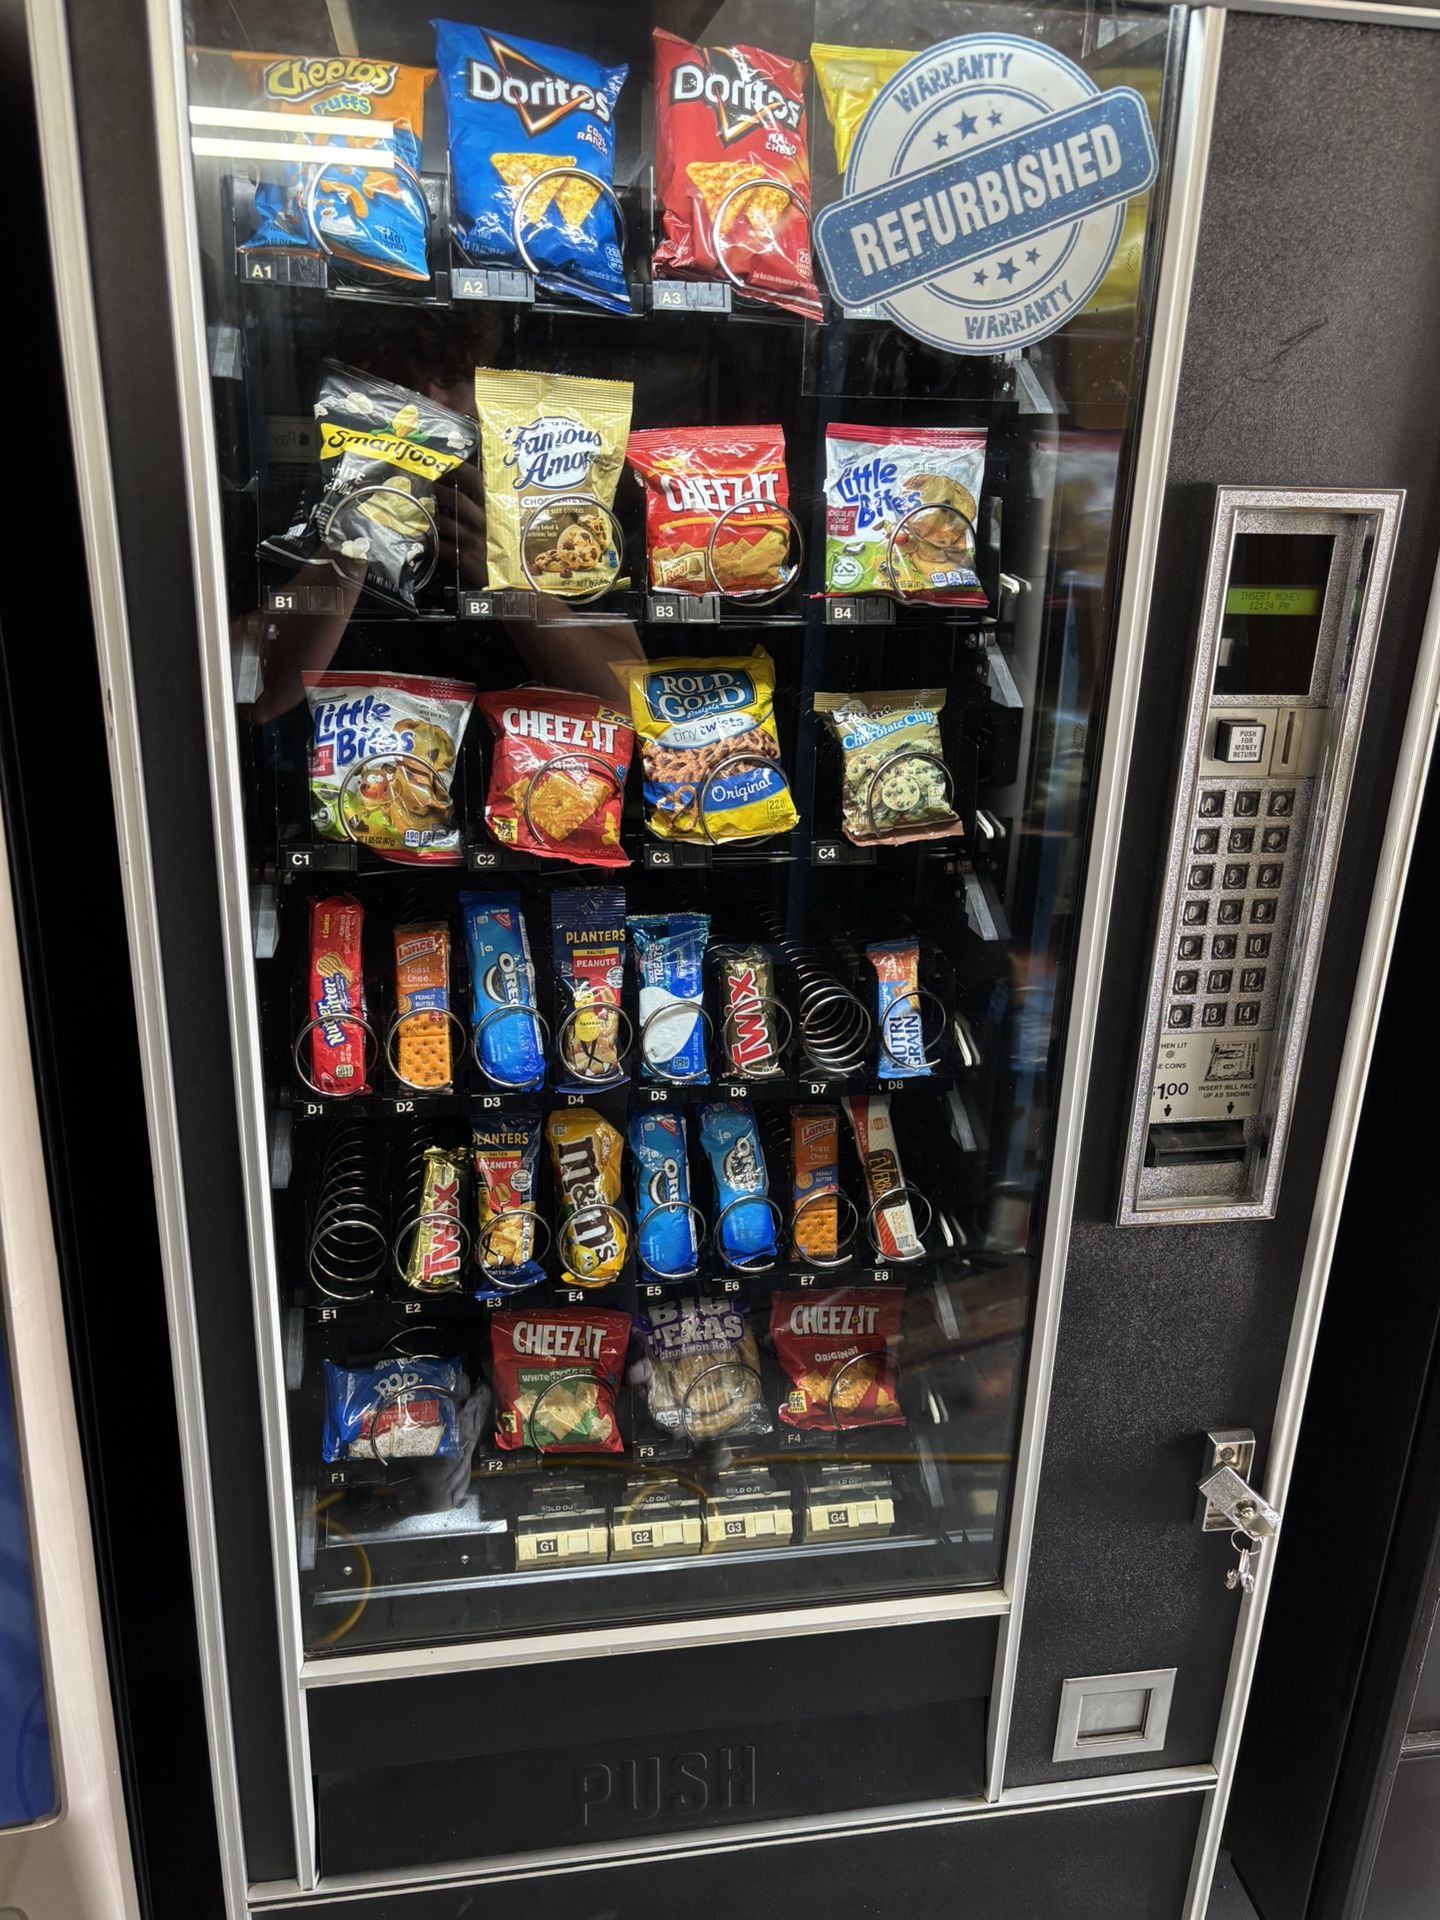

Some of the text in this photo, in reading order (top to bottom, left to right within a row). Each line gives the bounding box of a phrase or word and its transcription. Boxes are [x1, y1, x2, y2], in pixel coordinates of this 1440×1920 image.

[266, 59, 397, 98] Cheetos
[893, 52, 1015, 113] WARRANTY
[471, 61, 611, 122] Doritos
[674, 65, 800, 128] Doritos
[850, 124, 1122, 277] REFURBISHED
[251, 264, 272, 279] A1
[463, 281, 483, 294] A2
[661, 291, 681, 305] A3
[964, 280, 1074, 340] WARRANTY
[327, 429, 452, 474] Smartfood
[503, 424, 603, 467] Famous
[836, 458, 898, 504] Little
[857, 488, 923, 529] Bites
[274, 595, 293, 609] B1
[1240, 591, 1299, 601] INSERT MONEY
[470, 602, 490, 615] B2
[655, 605, 674, 618] B3
[1279, 602, 1290, 611] PM
[834, 607, 852, 620] B4
[658, 672, 735, 696] ROLD
[658, 684, 746, 720] GOLD
[314, 695, 391, 744] Little
[699, 716, 745, 736] twists
[904, 709, 935, 730] Chip
[673, 723, 699, 744] tiny
[1239, 729, 1257, 738] PUSH
[337, 728, 414, 766] Bites
[1235, 743, 1257, 751] MONEY
[1232, 750, 1258, 758] RETURN
[711, 774, 773, 803] Original
[291, 853, 310, 866] C1
[476, 853, 495, 866] C2
[652, 852, 670, 864] C3
[818, 847, 836, 860] C4
[565, 929, 626, 944] PLANTERS
[576, 958, 617, 967] PEANUTS
[654, 944, 665, 982] TREATS
[499, 952, 520, 1007] OREO
[414, 993, 436, 1002] PEANUT
[318, 1001, 345, 1046] Nuter
[889, 1016, 903, 1070] NUTRI
[907, 1014, 920, 1066] GRAIN
[1164, 1062, 1187, 1070] COINS
[810, 1084, 827, 1094] D7
[888, 1080, 904, 1090] D8
[1198, 1084, 1223, 1092] INSERT
[651, 1091, 667, 1101] D5
[730, 1087, 747, 1098] D6
[483, 1097, 501, 1108] D3
[568, 1095, 584, 1105] D4
[307, 1104, 323, 1115] D1
[396, 1102, 414, 1113] D2
[803, 1119, 835, 1139] Lance
[663, 1158, 678, 1214] OREO
[800, 1275, 816, 1286] E7
[874, 1271, 889, 1281] E8
[646, 1286, 662, 1296] E5
[725, 1281, 740, 1292] E6
[486, 1298, 502, 1307] E3
[568, 1291, 584, 1302] E4
[322, 1309, 338, 1319] E1
[405, 1303, 422, 1314] E2
[648, 1312, 745, 1349] TEXAS
[711, 1340, 732, 1352] Roll
[787, 1433, 801, 1443] F4
[639, 1447, 654, 1458] F3
[488, 1460, 503, 1471] F2
[331, 1472, 345, 1483] F1
[830, 1512, 846, 1522] G4
[726, 1522, 742, 1533] G3
[634, 1532, 650, 1543] G2
[540, 1541, 555, 1551] G1
[572, 1745, 756, 1827] PUSH
